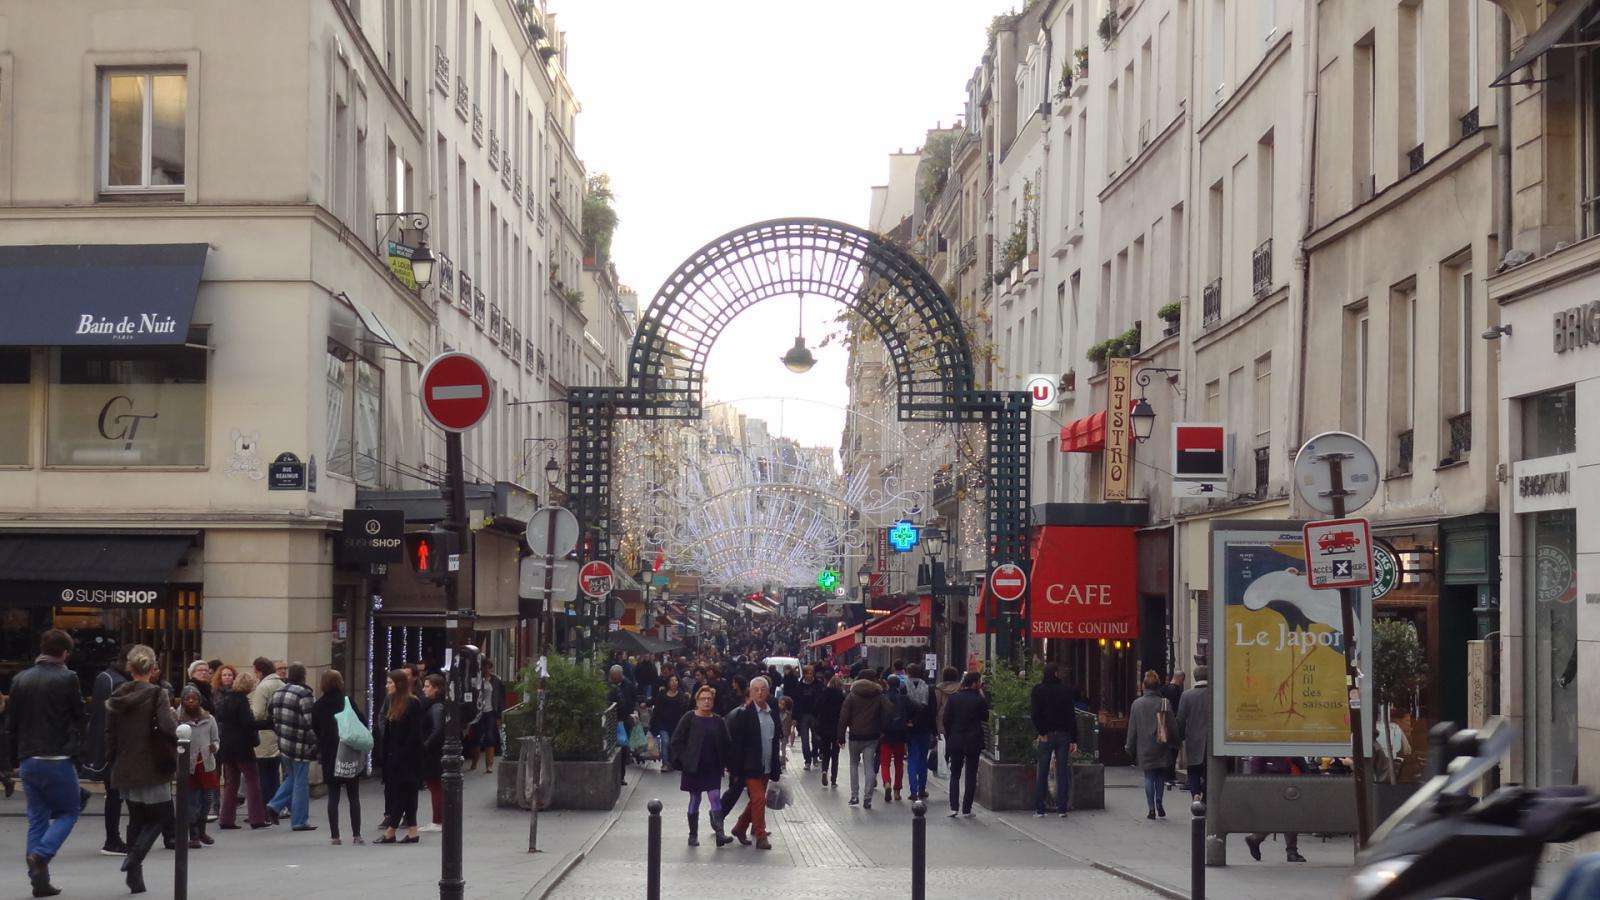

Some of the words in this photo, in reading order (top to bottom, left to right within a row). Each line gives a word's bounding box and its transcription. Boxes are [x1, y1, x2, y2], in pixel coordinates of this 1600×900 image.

[76, 314, 113, 334] Bain
[116, 316, 135, 333] de
[138, 313, 176, 333] Nuit
[1033, 386, 1048, 400] U
[1111, 376, 1126, 481] BISTRO
[1046, 584, 1112, 605] CAFE
[1032, 621, 1073, 633] SERVICE
[1078, 622, 1128, 634] CONTINU
[1234, 622, 1270, 646] Le
[1303, 664, 1315, 673] au
[1303, 687, 1321, 697] des
[1303, 701, 1343, 709] saisons
